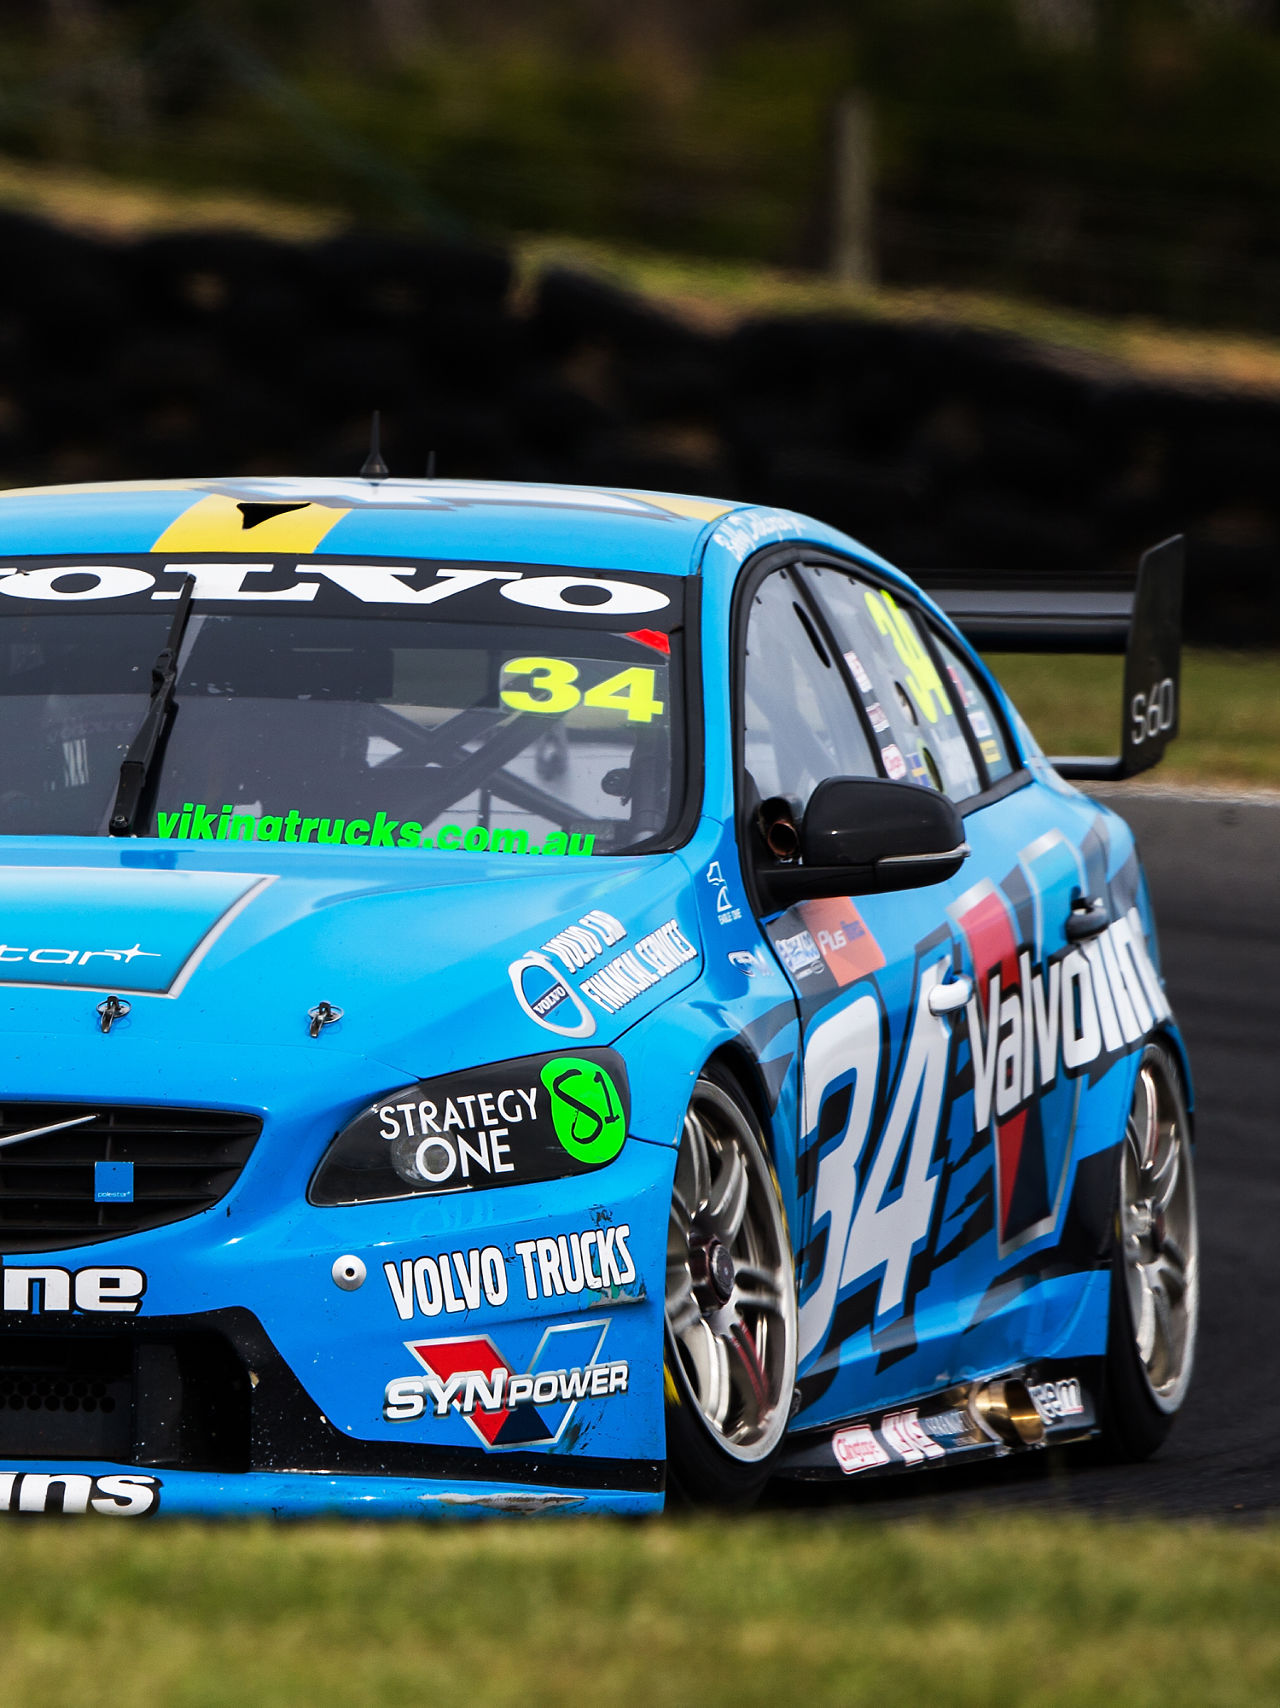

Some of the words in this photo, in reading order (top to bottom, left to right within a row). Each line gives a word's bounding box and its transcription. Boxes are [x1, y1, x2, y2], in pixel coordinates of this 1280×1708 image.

[500, 657, 665, 723] 34
[1131, 678, 1175, 745] S60
[157, 803, 596, 857] vikingtrucks.com.au
[541, 925, 603, 974] VOLVO
[579, 949, 661, 1015] FINANCIAL
[634, 918, 699, 977] SERVICES
[533, 984, 567, 1015] VOLVO
[379, 1087, 537, 1140] STRATEGY
[415, 1128, 515, 1183] ONE
[796, 956, 951, 1368] 34
[382, 1246, 509, 1321] VOLVO
[515, 1223, 637, 1300] TRUCKS
[383, 1360, 629, 1424] SYNPOWER
